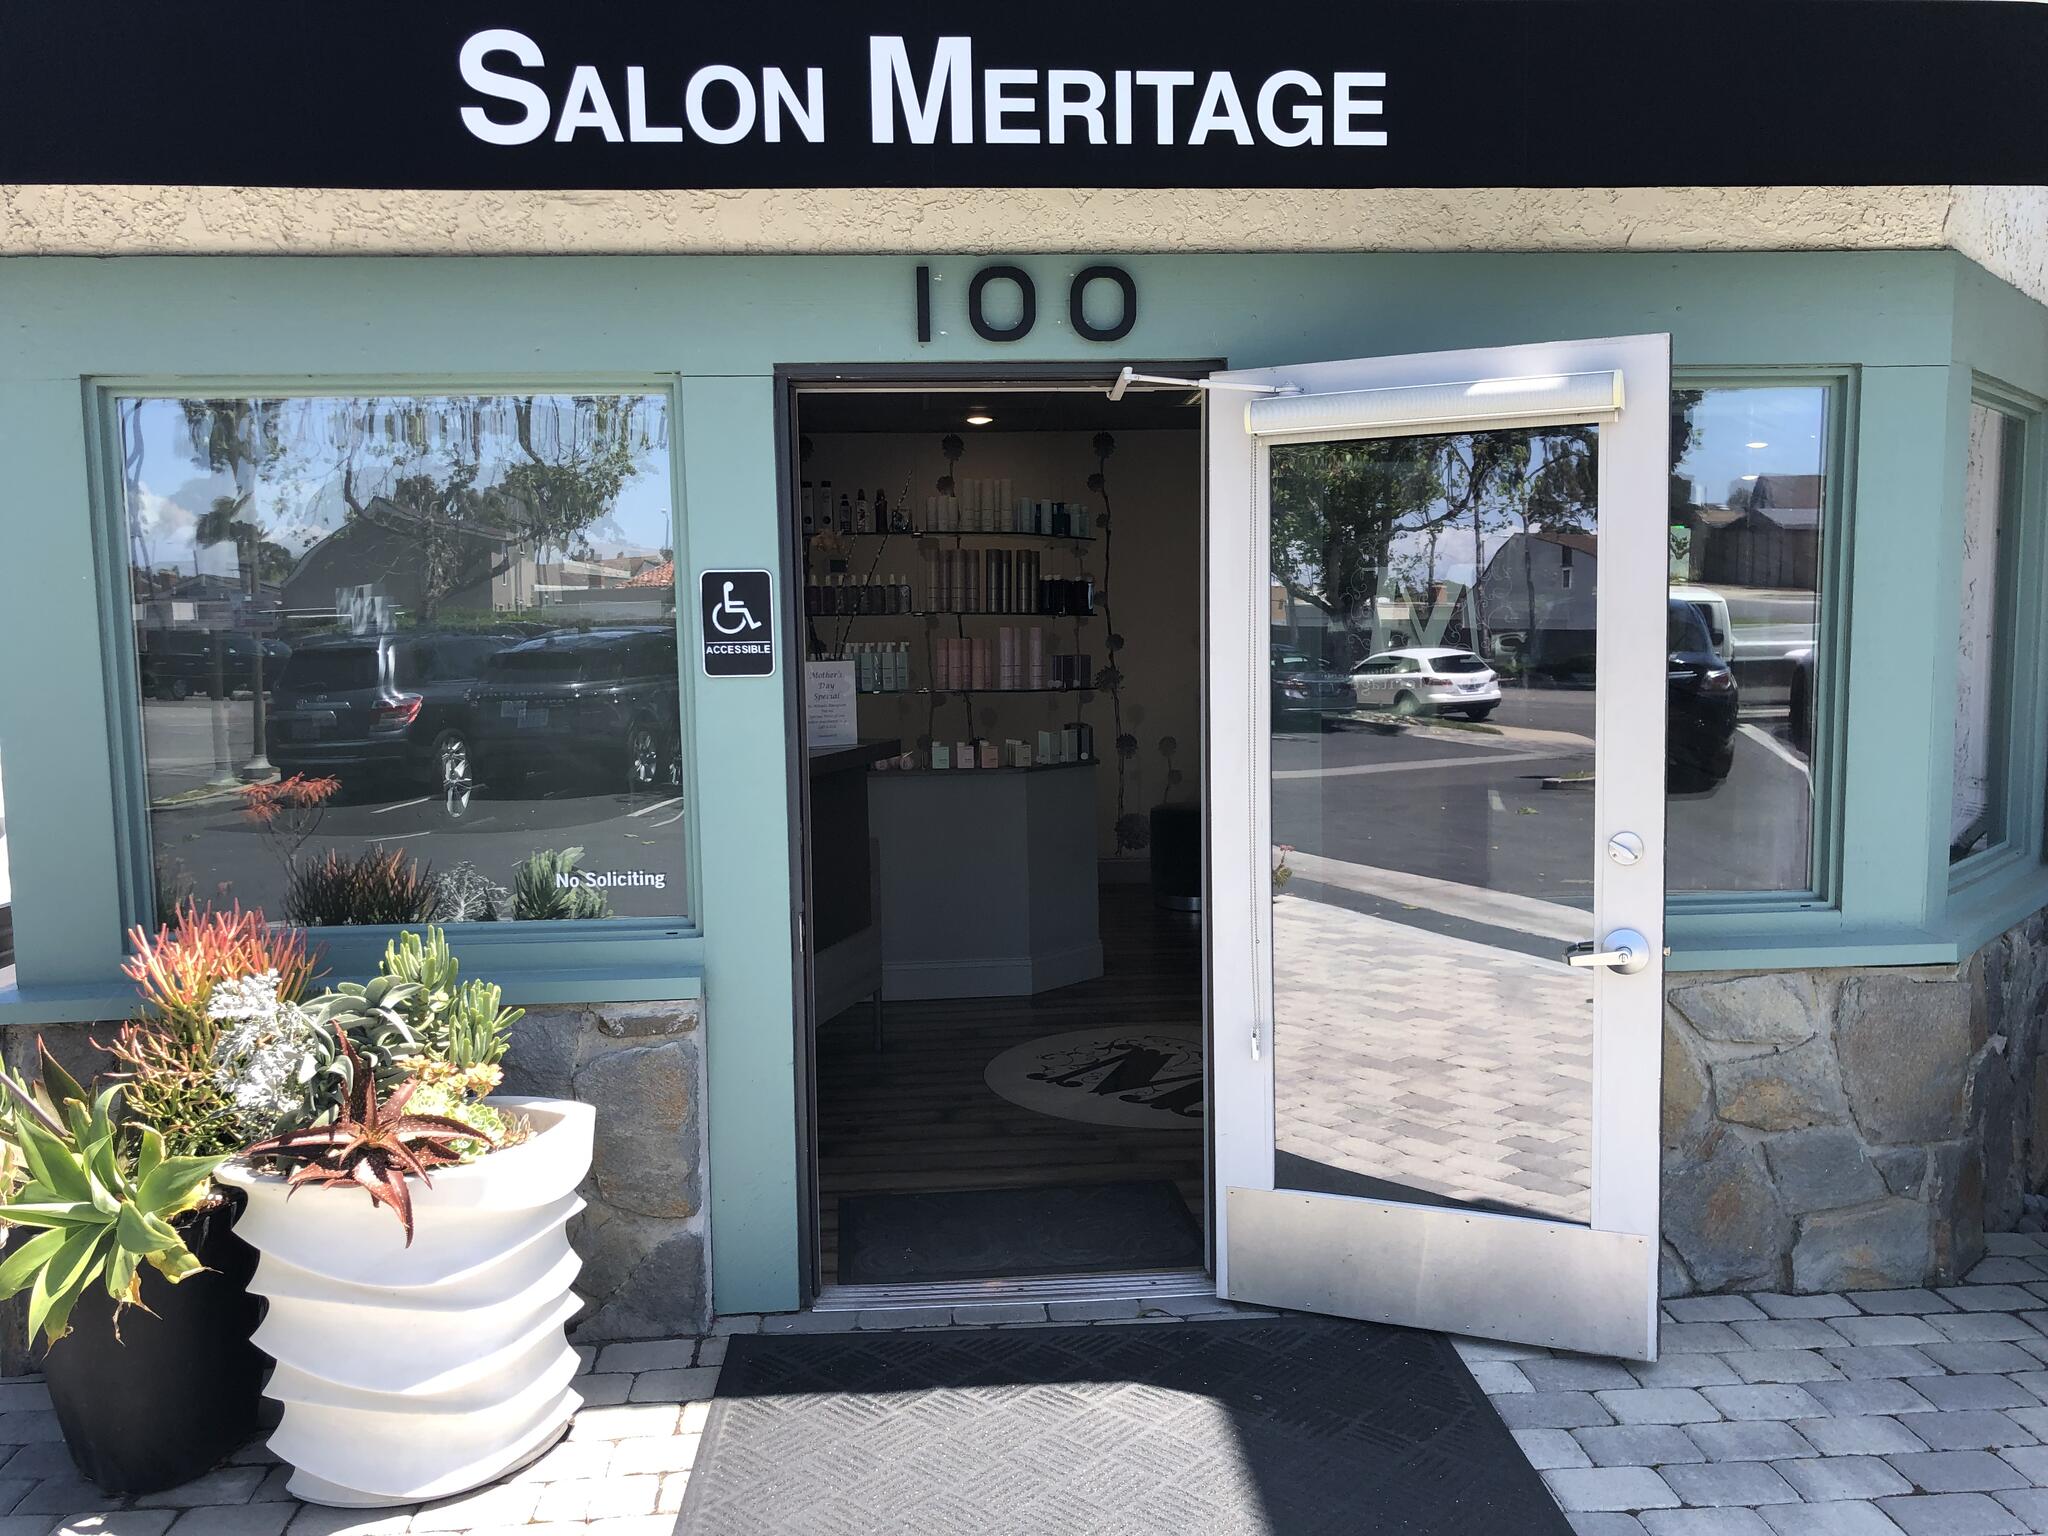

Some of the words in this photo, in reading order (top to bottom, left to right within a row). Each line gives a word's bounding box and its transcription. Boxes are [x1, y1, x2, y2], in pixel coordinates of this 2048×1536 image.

[460, 29, 824, 145] SALON
[870, 36, 1387, 147] MERITAGE
[916, 266, 1137, 342] 100
[706, 645, 771, 654] ACCESSIBLE
[817, 682, 836, 690] Day
[555, 873, 580, 888] No
[586, 871, 665, 889] Soliciting
